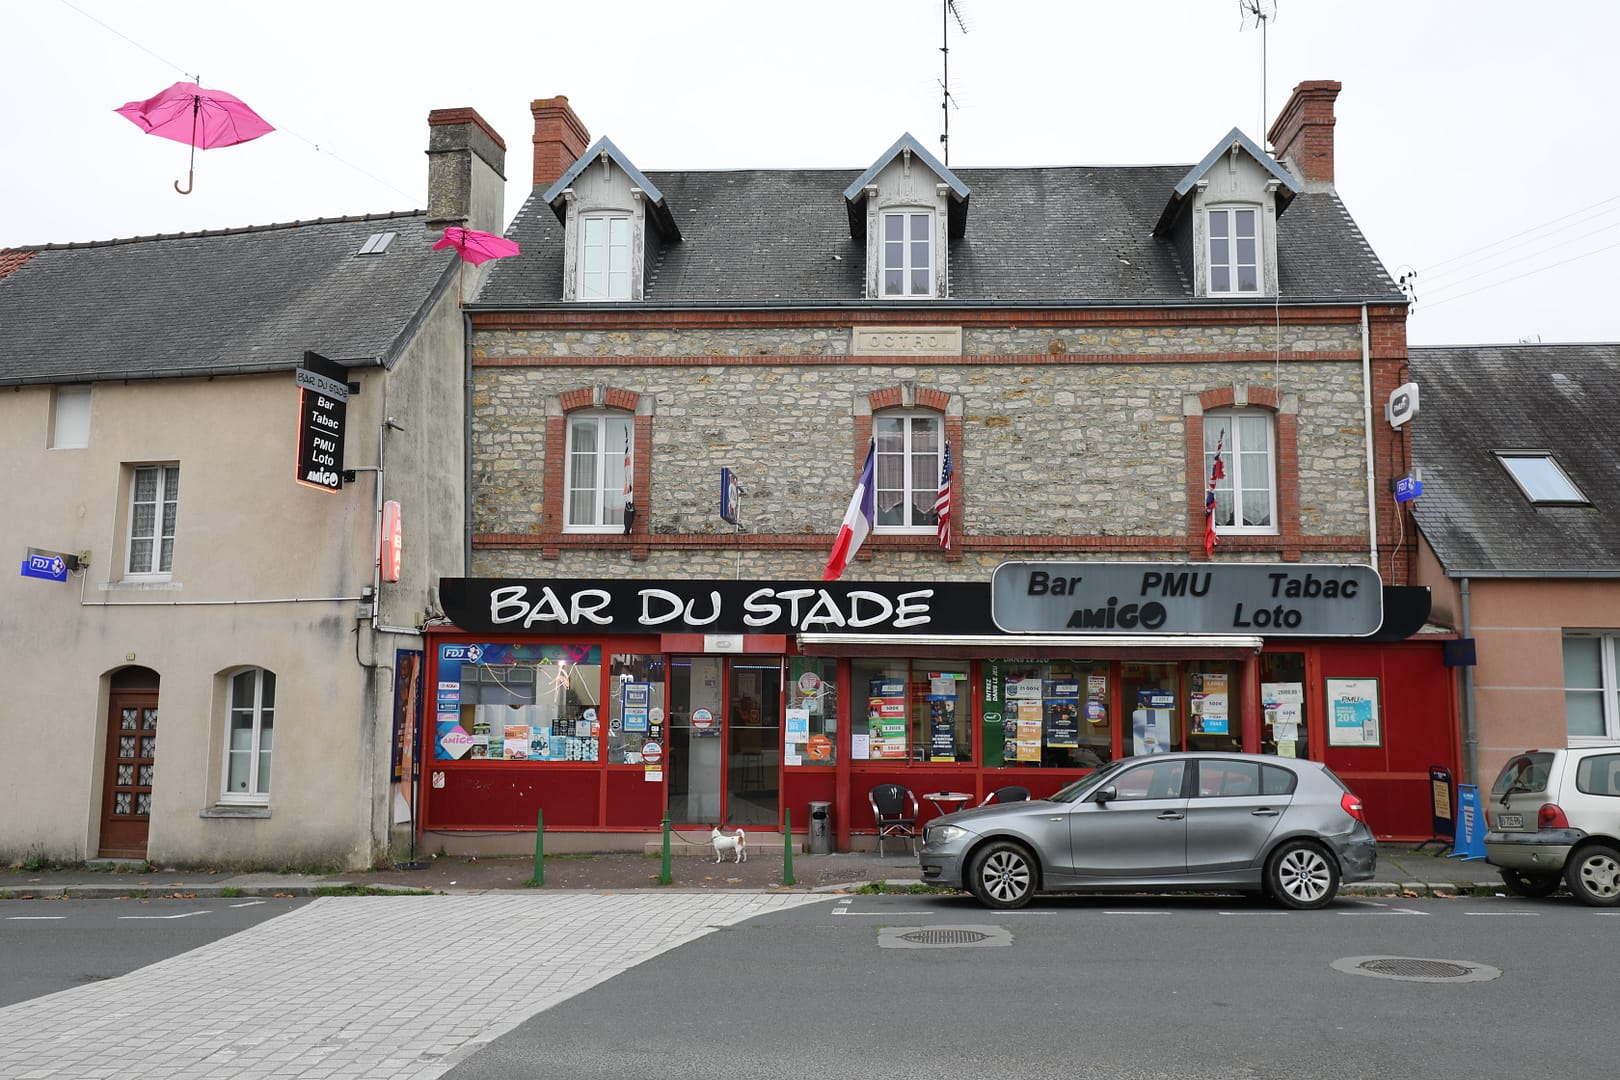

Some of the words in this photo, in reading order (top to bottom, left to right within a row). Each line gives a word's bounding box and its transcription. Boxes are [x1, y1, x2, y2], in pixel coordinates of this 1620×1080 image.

[298, 372, 315, 386] BAR
[318, 380, 328, 390] DU
[329, 384, 348, 398] STADE
[318, 396, 334, 410] Bar
[312, 410, 339, 429] Tabac
[313, 438, 335, 452] PMU
[312, 450, 334, 466] Loto
[32, 558, 50, 568] FDJ
[1027, 571, 1082, 596] Bar
[1140, 572, 1212, 597] PMU
[1268, 573, 1358, 598] Tabac
[490, 586, 612, 628] BAR
[638, 588, 722, 626] DU
[743, 588, 934, 631] STADE
[1233, 603, 1302, 628] Loto
[446, 649, 464, 657] FDJ
[1341, 696, 1360, 704] PMU
[1336, 714, 1350, 722] 20
